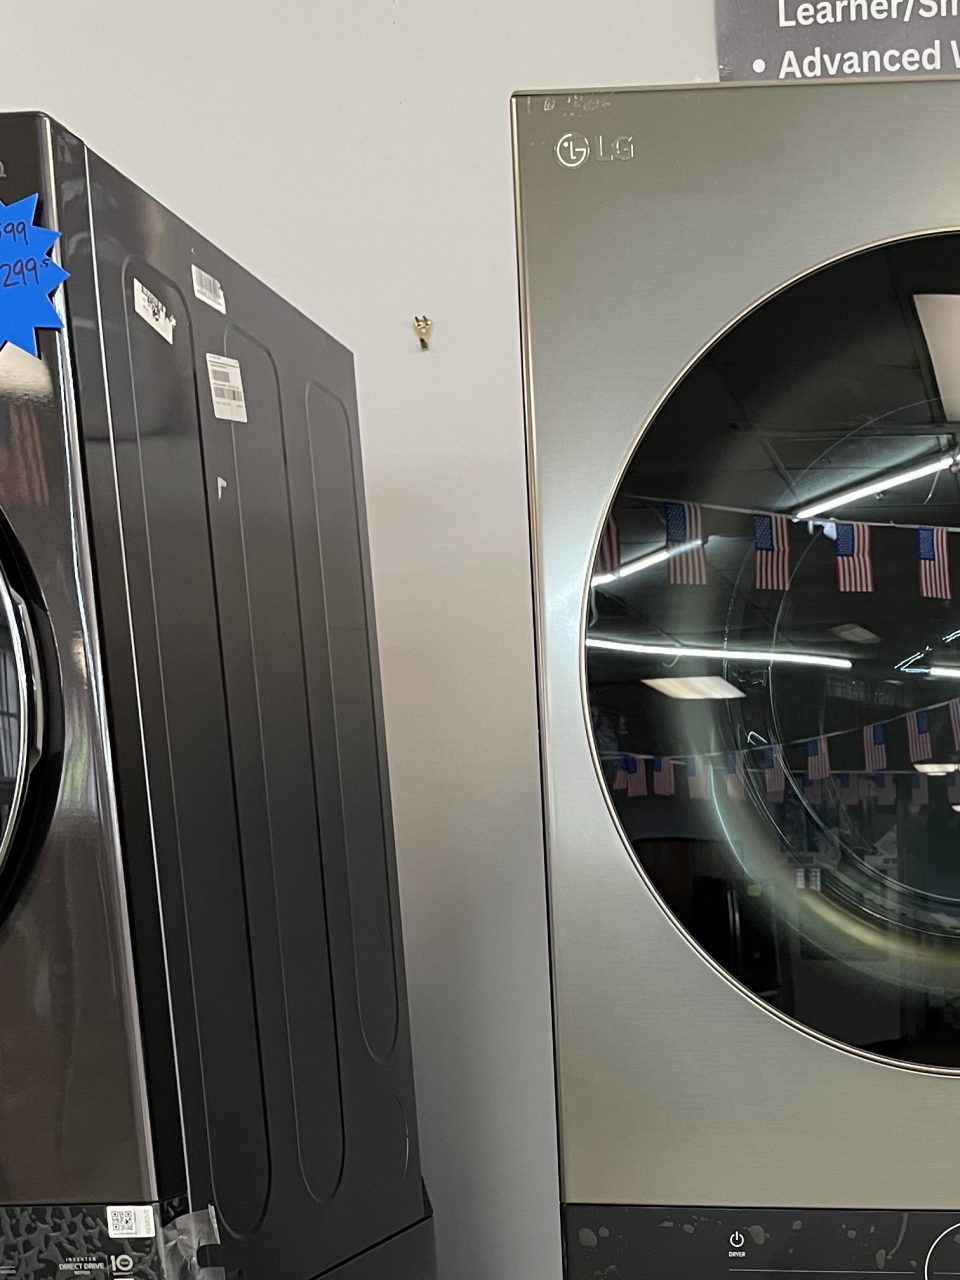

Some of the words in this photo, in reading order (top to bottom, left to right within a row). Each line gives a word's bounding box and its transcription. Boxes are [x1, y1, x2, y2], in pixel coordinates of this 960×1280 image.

[778, 39, 941, 79] Advanced
[595, 135, 635, 162] LG
[59, 1263, 82, 1271] DIRECT
[84, 1262, 105, 1270] DRIVE
[111, 1254, 134, 1272] 10
